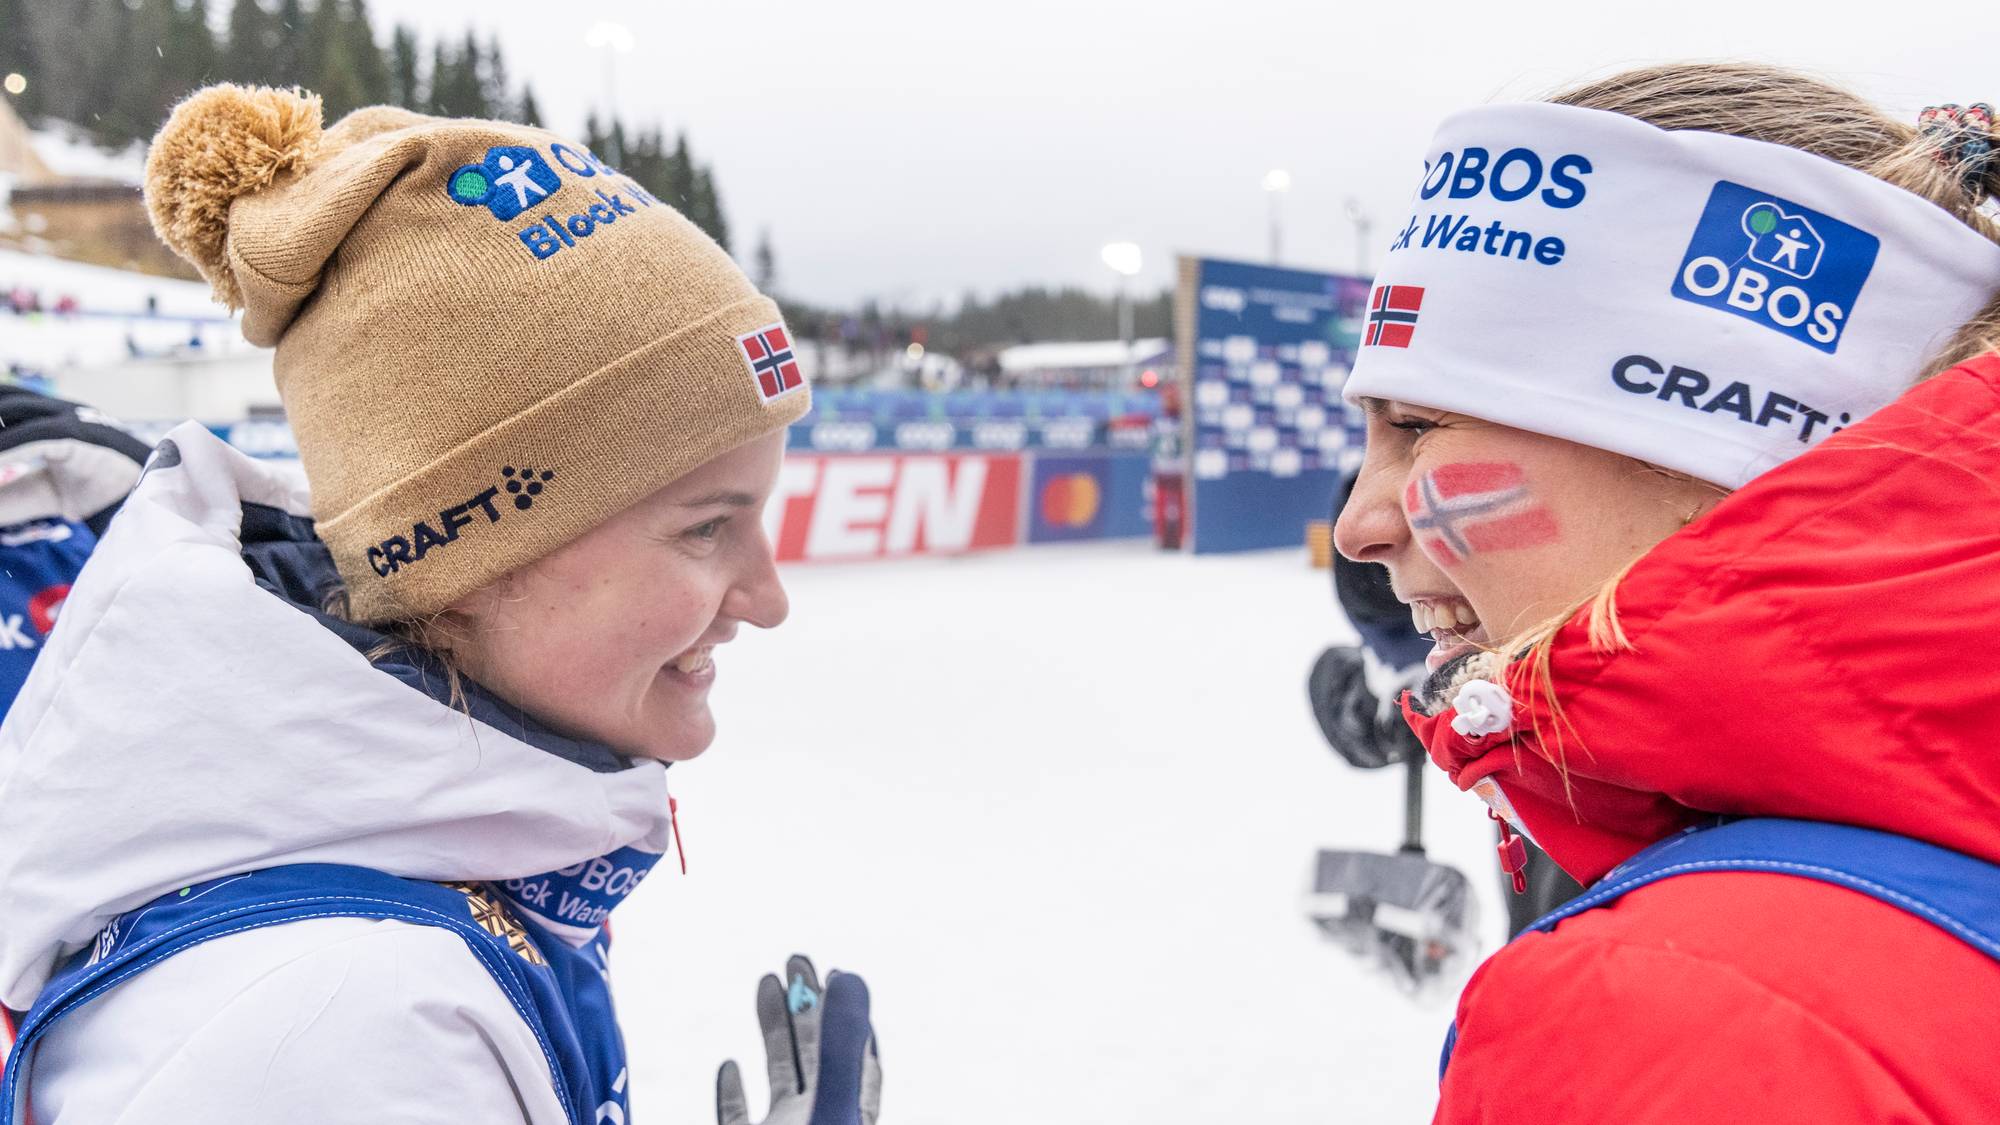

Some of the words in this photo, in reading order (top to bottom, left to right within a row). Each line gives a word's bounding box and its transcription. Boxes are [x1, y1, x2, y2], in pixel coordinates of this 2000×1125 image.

[1421, 147, 1593, 209] OBOS
[519, 188, 636, 260] Block
[1421, 214, 1566, 265] Watne
[1683, 256, 1843, 343] OBOS
[1611, 355, 1829, 443] CRAFT
[367, 485, 500, 578] CRAFT
